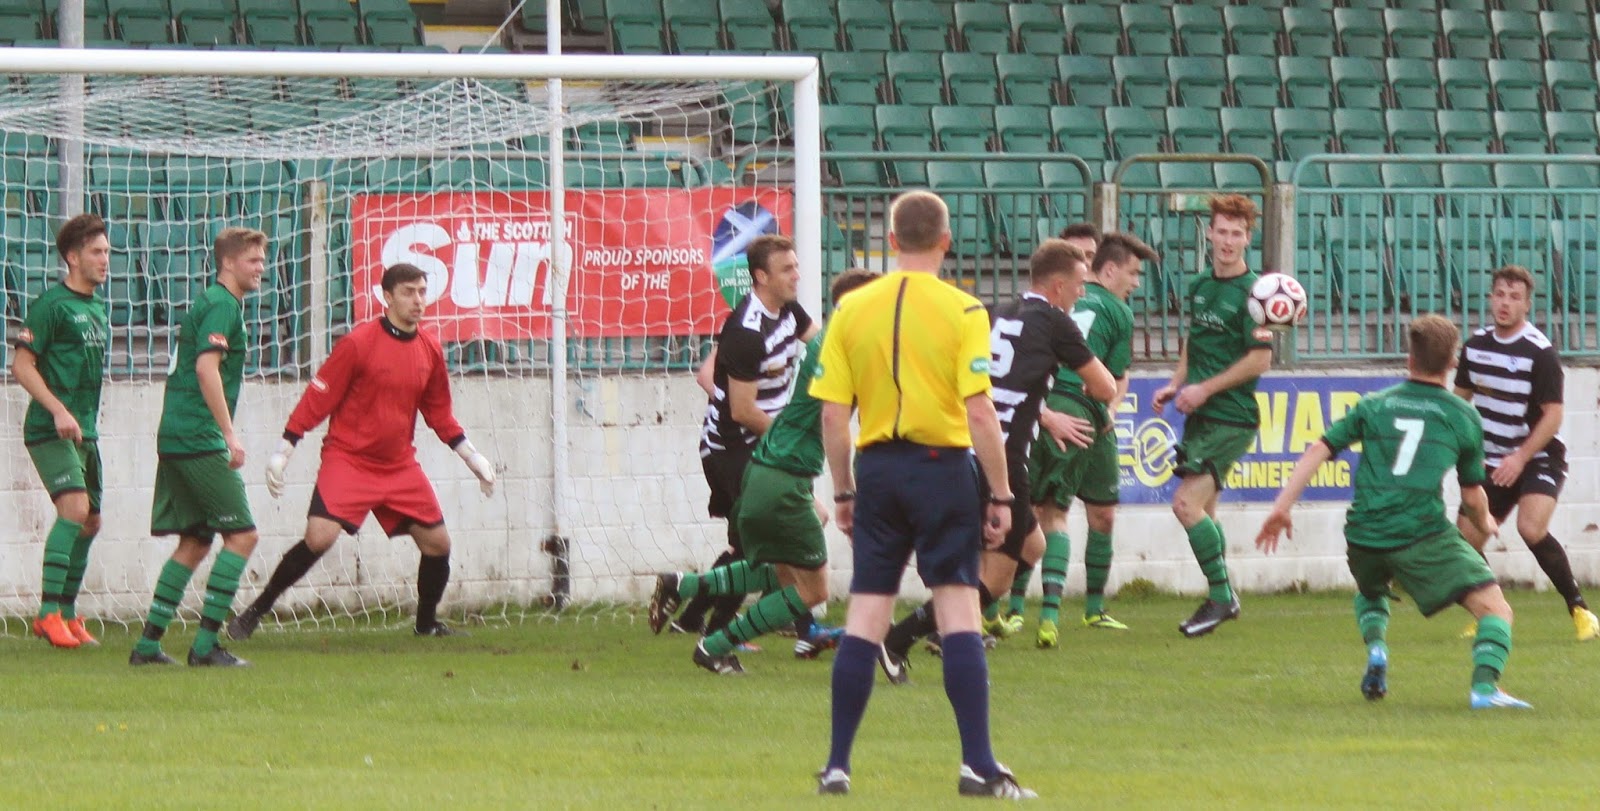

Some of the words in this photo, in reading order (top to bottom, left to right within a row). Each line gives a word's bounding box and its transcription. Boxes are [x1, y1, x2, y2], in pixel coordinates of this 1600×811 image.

[474, 221, 500, 241] THE
[503, 220, 572, 241] SCOTTIH
[373, 222, 573, 309] Sun
[584, 248, 632, 267] PROUD
[634, 247, 704, 266] SPONSORS
[621, 273, 640, 290] OF
[642, 273, 669, 290] THE
[1392, 417, 1425, 476] 7
